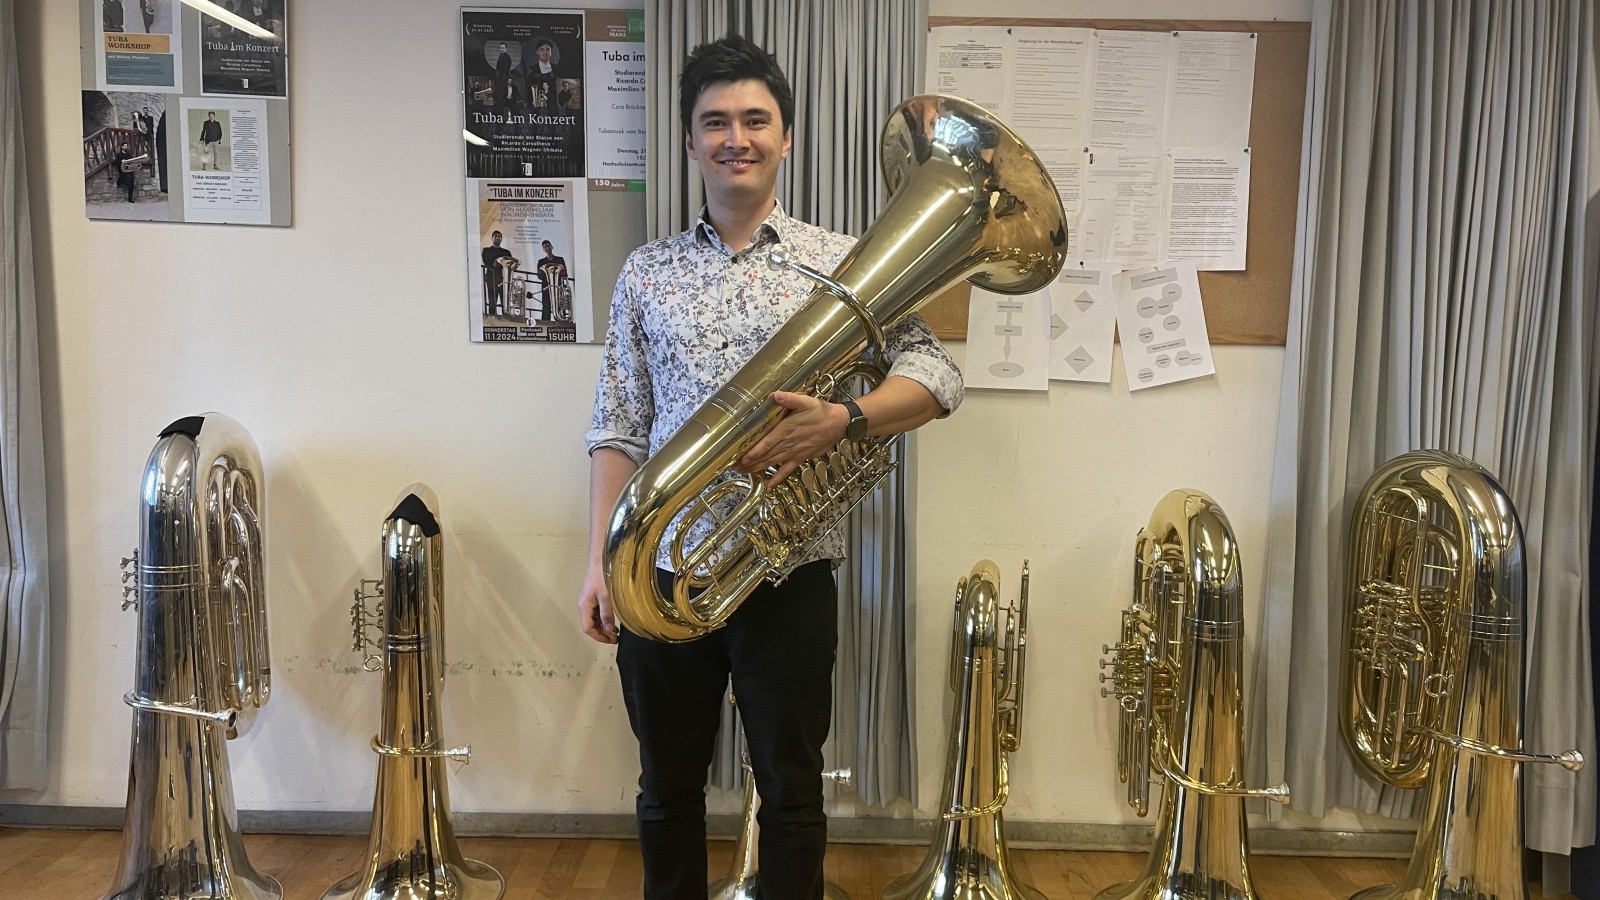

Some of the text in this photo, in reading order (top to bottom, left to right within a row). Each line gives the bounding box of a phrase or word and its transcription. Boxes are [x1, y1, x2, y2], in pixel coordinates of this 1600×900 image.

[108, 42, 152, 50] WORKSHOP
[206, 41, 229, 51] Tuba
[246, 43, 280, 53] Konzert
[602, 50, 630, 62] Tuba
[472, 111, 504, 124] Tuba
[528, 113, 576, 126] Konzert
[514, 188, 524, 198] IM
[484, 333, 516, 341] 11.1.2024
[548, 333, 575, 341] 15UHR
